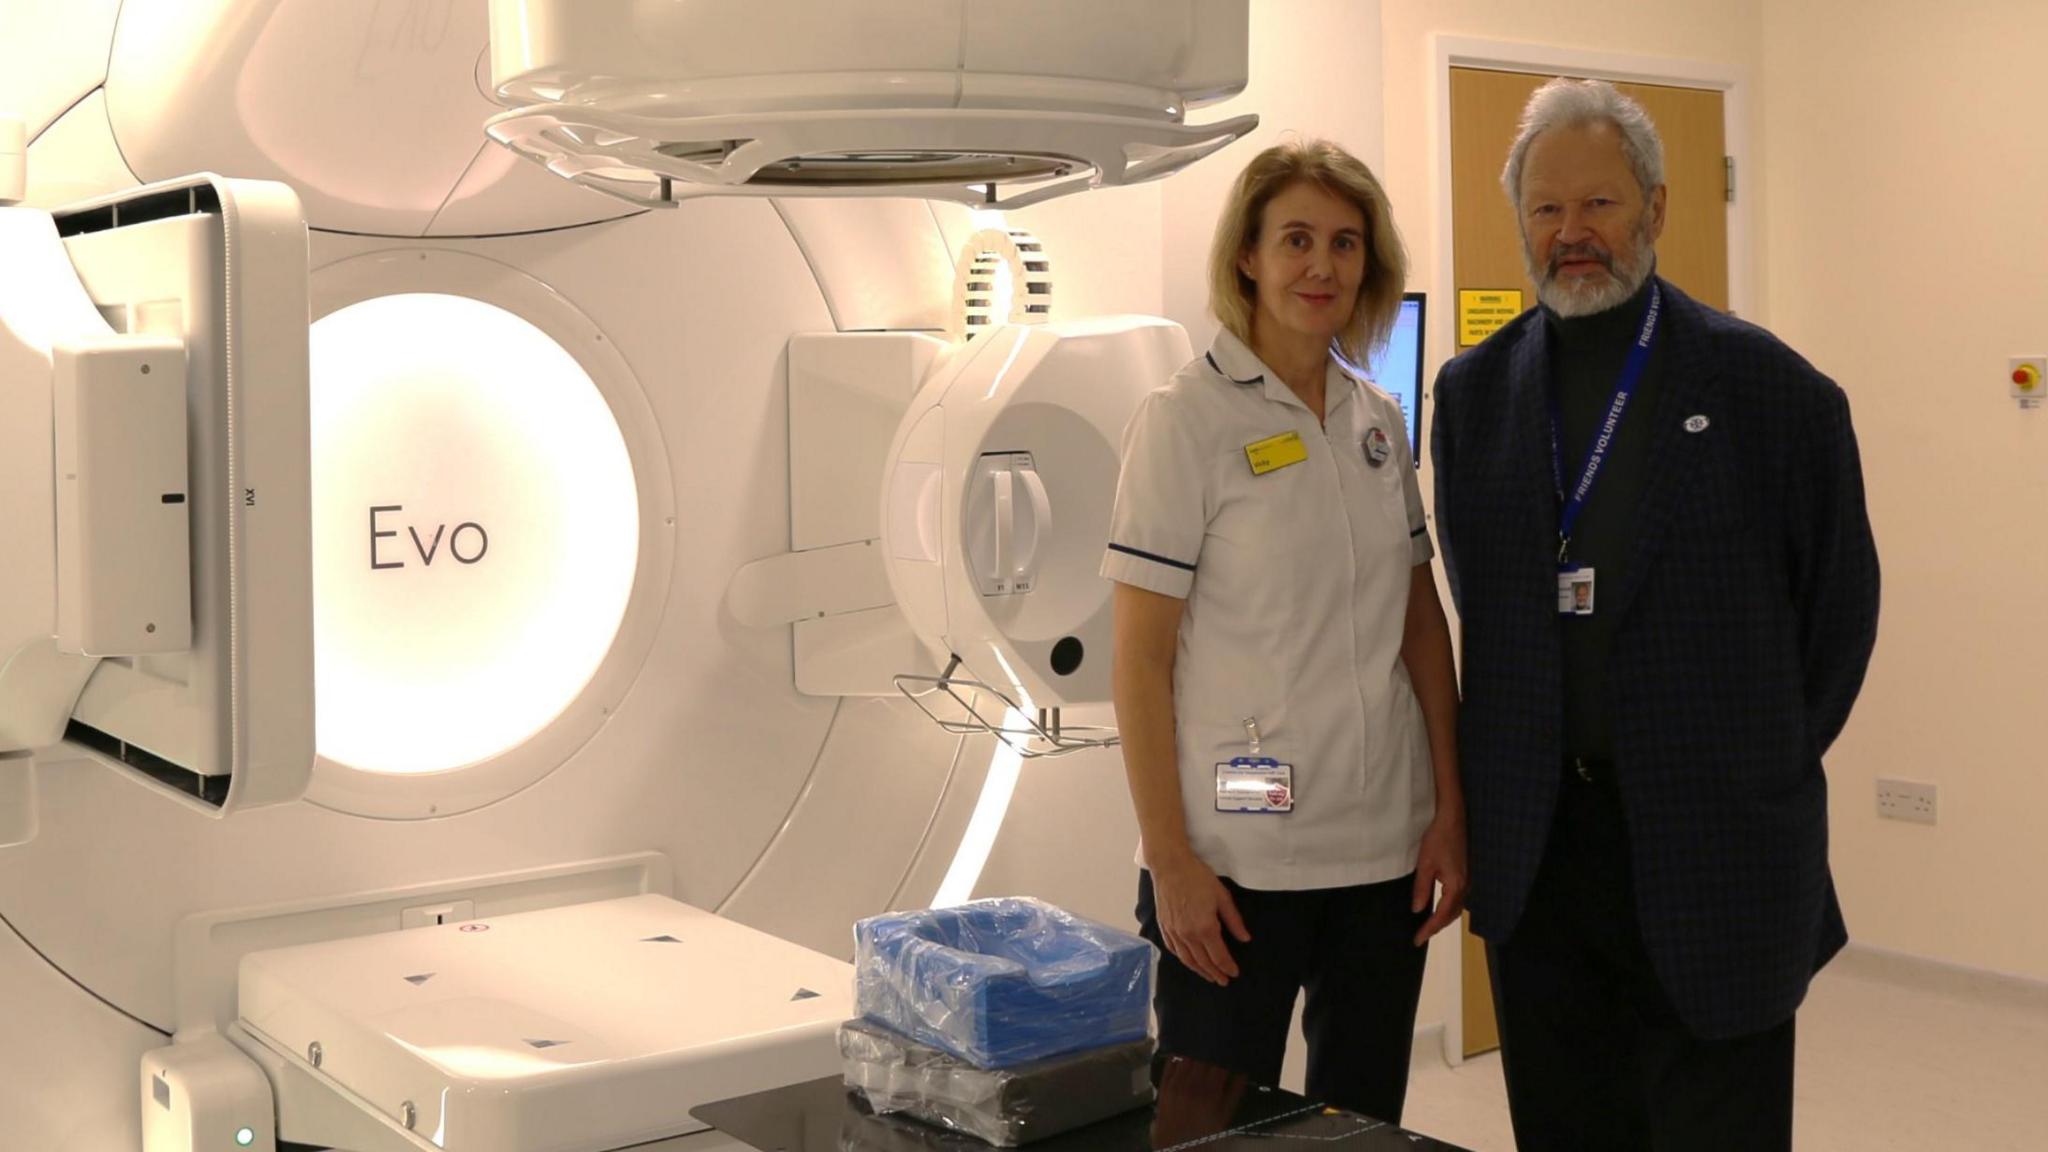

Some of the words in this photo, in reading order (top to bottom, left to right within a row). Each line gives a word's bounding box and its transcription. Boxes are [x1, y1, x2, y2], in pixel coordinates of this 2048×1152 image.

[1638, 309, 1658, 347] FRIENDS
[1575, 454, 1601, 502] FRIENDS
[1594, 391, 1628, 454] VOLUNTEER
[245, 488, 256, 507] XVI
[370, 505, 488, 570] Evo
